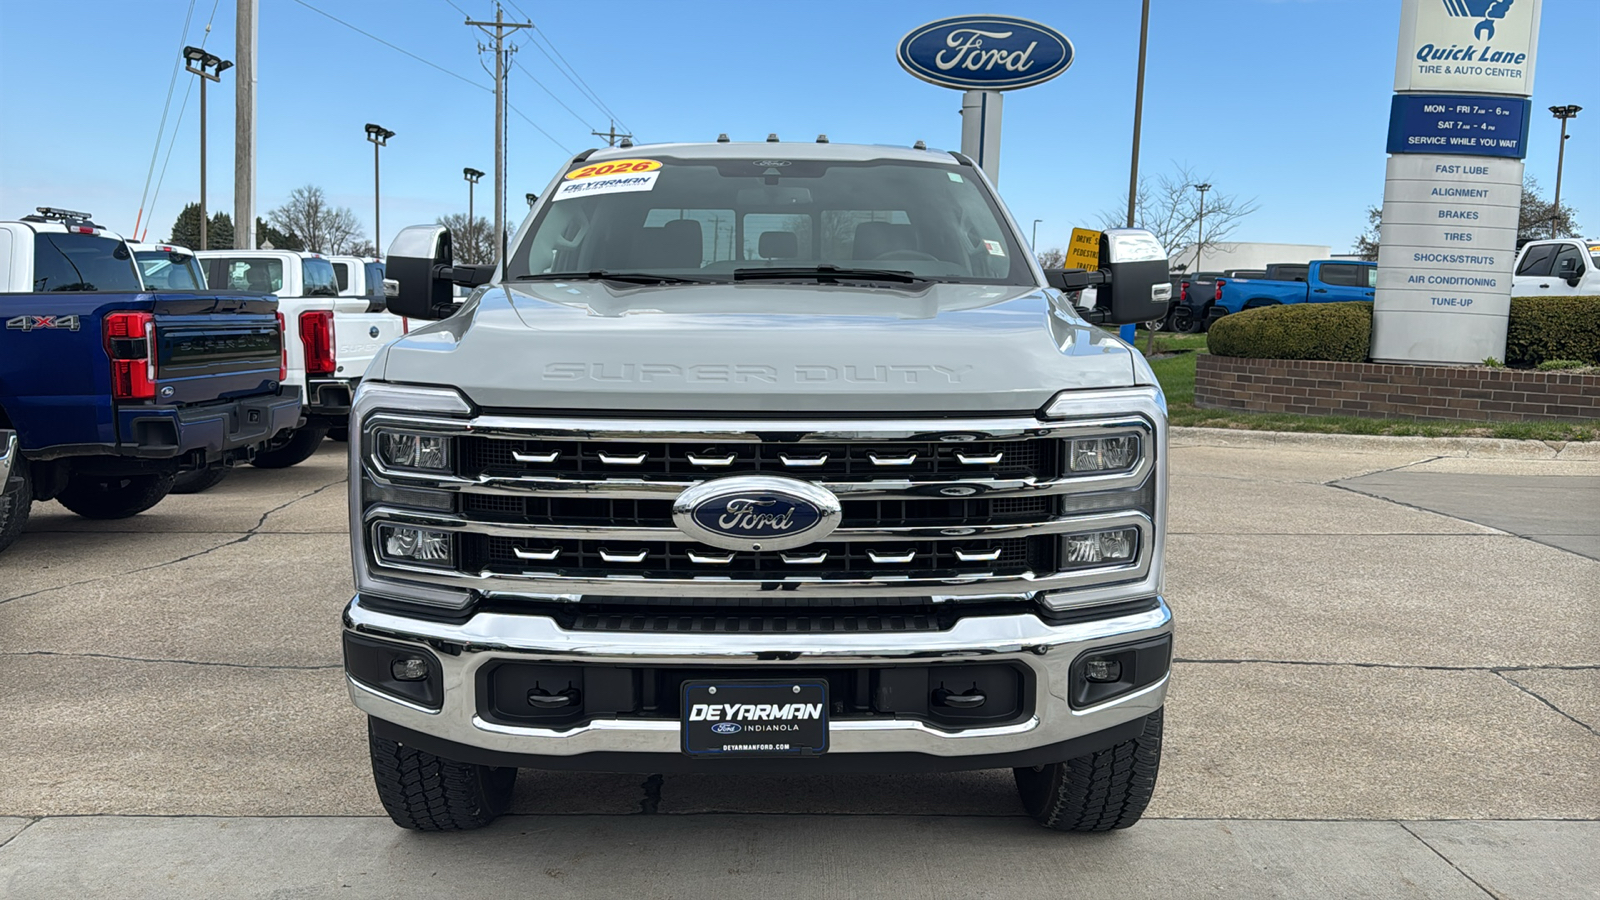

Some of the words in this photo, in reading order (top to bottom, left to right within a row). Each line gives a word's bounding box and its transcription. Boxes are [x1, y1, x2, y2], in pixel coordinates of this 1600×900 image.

[935, 28, 1038, 72] Ford
[1416, 44, 1478, 62] Quick
[1478, 46, 1526, 64] Lane
[1418, 65, 1442, 74] TIRE
[1444, 66, 1452, 74] &
[1454, 66, 1482, 75] AUTO
[1485, 67, 1522, 78] CENTER
[1424, 105, 1445, 113] MON
[1457, 105, 1470, 114] FRI
[1437, 121, 1454, 129] SAT
[1408, 136, 1446, 145] SERVICE
[1450, 138, 1477, 146] WHILE
[1480, 138, 1497, 147] YOU
[1499, 140, 1517, 148] WAIT
[574, 162, 652, 178] 2026
[1435, 165, 1461, 174] FAST
[1463, 166, 1489, 175] LUBE
[563, 177, 651, 191] DEYARMAN
[1431, 187, 1489, 198] ALIGNMENT
[1438, 210, 1479, 220] BRAKES
[1076, 235, 1092, 244] DRIVE
[1444, 232, 1472, 242] TIRES
[1413, 253, 1495, 265] SHOCKS/STRUTS
[1408, 275, 1425, 284] AIR
[1428, 276, 1496, 287] CONDITIONING
[1431, 297, 1473, 308] TUNE-UP
[180, 340, 235, 351] SUPER
[542, 362, 778, 384] SUPER
[795, 364, 974, 384] DUTY
[718, 498, 795, 530] Ford
[689, 704, 823, 721] DEYARMAN
[744, 724, 799, 732] INDIANOLA
